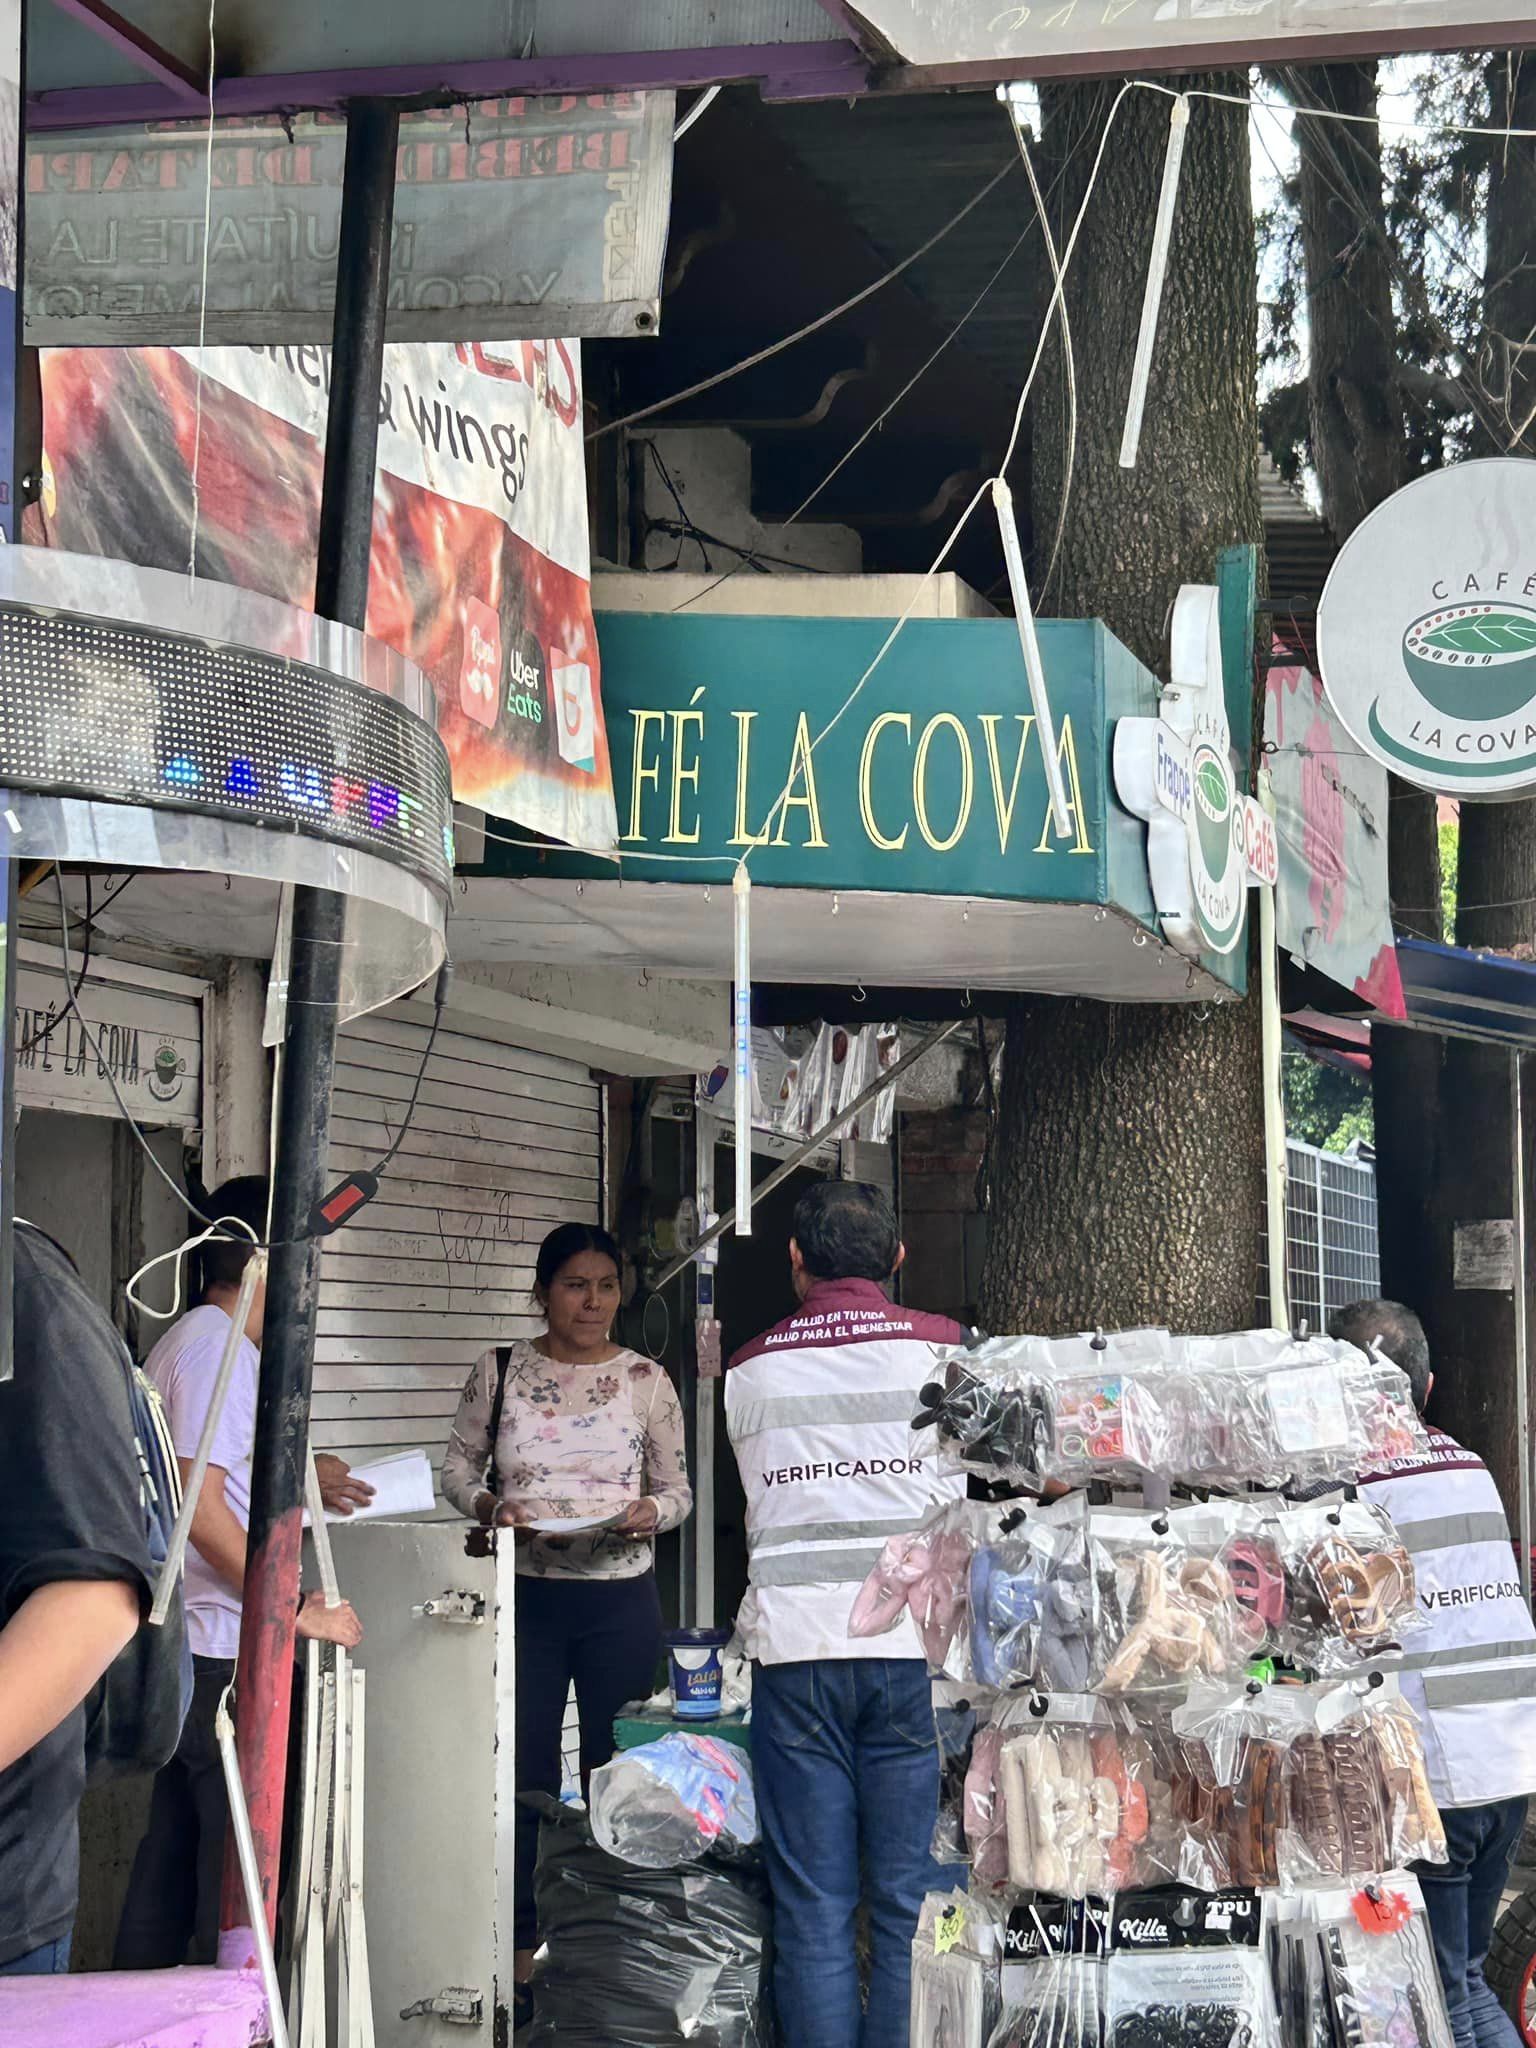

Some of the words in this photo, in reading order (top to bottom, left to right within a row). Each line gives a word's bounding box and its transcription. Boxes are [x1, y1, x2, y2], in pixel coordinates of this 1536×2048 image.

[403, 379, 529, 504] wings
[1432, 571, 1536, 601] CAFÉ
[510, 648, 540, 690] Uber
[507, 683, 542, 724] Eats
[1409, 720, 1441, 749] LA
[1456, 724, 1536, 753] COVA
[621, 686, 704, 845] FÉ
[726, 710, 829, 848] LA
[858, 711, 1094, 856] COVA
[1157, 732, 1191, 818] Frappé
[1245, 807, 1276, 881] Café
[16, 1000, 57, 1072] AFÉ
[765, 1332, 800, 1346] SALUD
[801, 1327, 832, 1341] PARA
[834, 1325, 849, 1338] EL
[852, 1321, 913, 1335] BIENESTAR
[790, 1314, 825, 1329] SALUD
[826, 1311, 841, 1324] EN
[843, 1310, 859, 1321] TU
[859, 1310, 887, 1320] VIDA
[762, 1458, 923, 1488] VERIFICADOR
[1421, 1581, 1521, 1610] VERIFICADO
[1206, 1900, 1252, 1917] TPU
[1006, 1928, 1041, 1952] Kill
[1118, 1917, 1169, 1941] Killa
